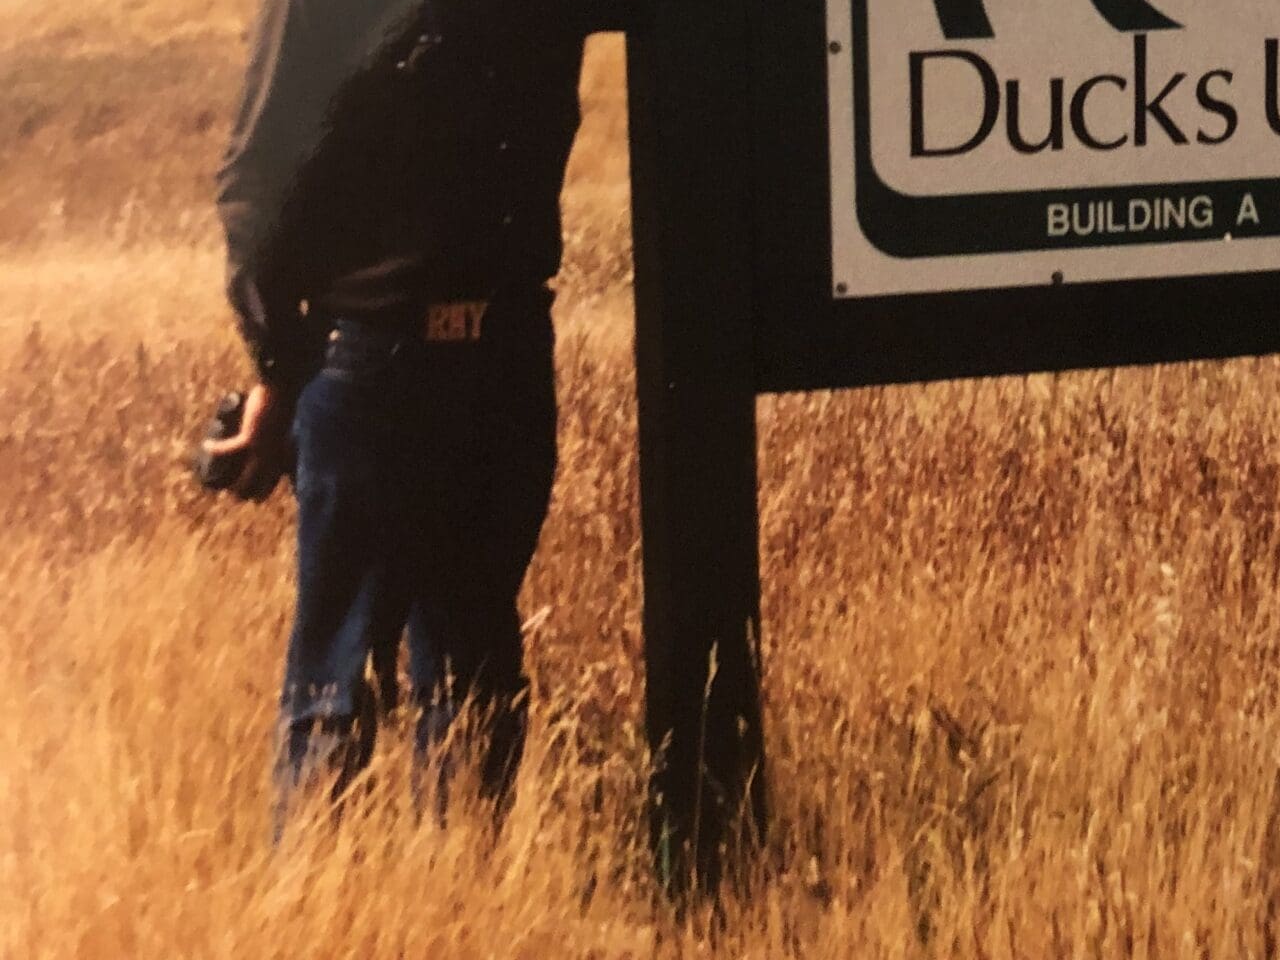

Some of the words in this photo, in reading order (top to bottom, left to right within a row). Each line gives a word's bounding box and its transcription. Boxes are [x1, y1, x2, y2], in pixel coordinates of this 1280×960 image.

[908, 33, 1239, 158] Ducks
[1046, 194, 1214, 237] BUILDING
[1235, 192, 1260, 225] A
